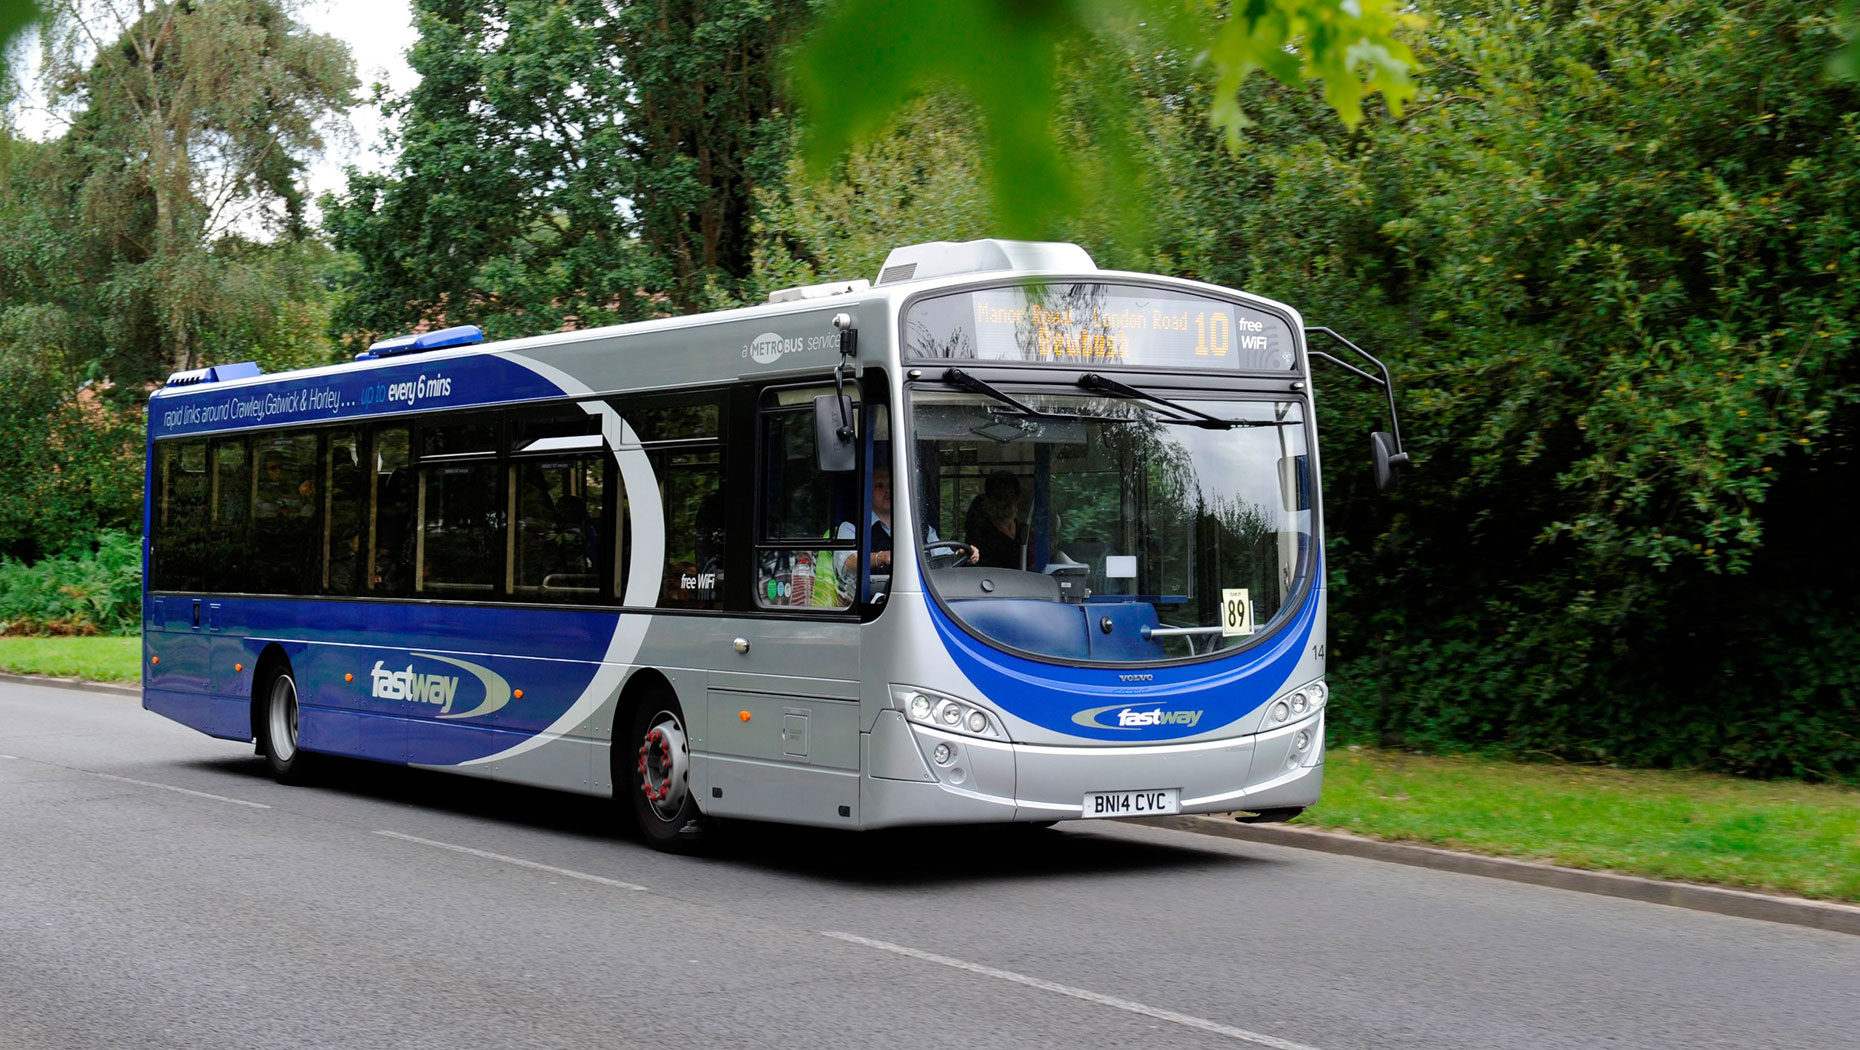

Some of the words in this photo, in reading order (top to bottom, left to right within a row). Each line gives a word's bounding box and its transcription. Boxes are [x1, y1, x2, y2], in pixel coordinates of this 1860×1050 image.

[977, 301, 1026, 324] Manor
[1093, 307, 1146, 329] London
[1153, 310, 1188, 331] Road
[1239, 317, 1263, 332] free
[741, 345, 748, 358] a
[751, 337, 803, 357] METROBUS
[807, 332, 841, 351] service
[1195, 311, 1229, 357] 10
[1241, 335, 1268, 350] WiFi
[163, 405, 184, 430] rapid
[183, 404, 201, 425] links
[201, 400, 230, 423] around
[265, 391, 300, 415] Gatwick
[300, 388, 308, 411] &
[361, 385, 374, 409] up
[375, 383, 386, 403] to
[388, 381, 416, 406] every
[417, 374, 426, 399] 6
[426, 371, 451, 398] mins
[680, 573, 697, 589] free
[697, 573, 715, 589] WiFi
[1228, 599, 1245, 627] 89
[370, 660, 460, 714] fastway
[1118, 673, 1154, 682] VOLVO
[1117, 708, 1204, 727] fastway
[1094, 794, 1131, 814] BN14
[1135, 792, 1166, 811] CVC
